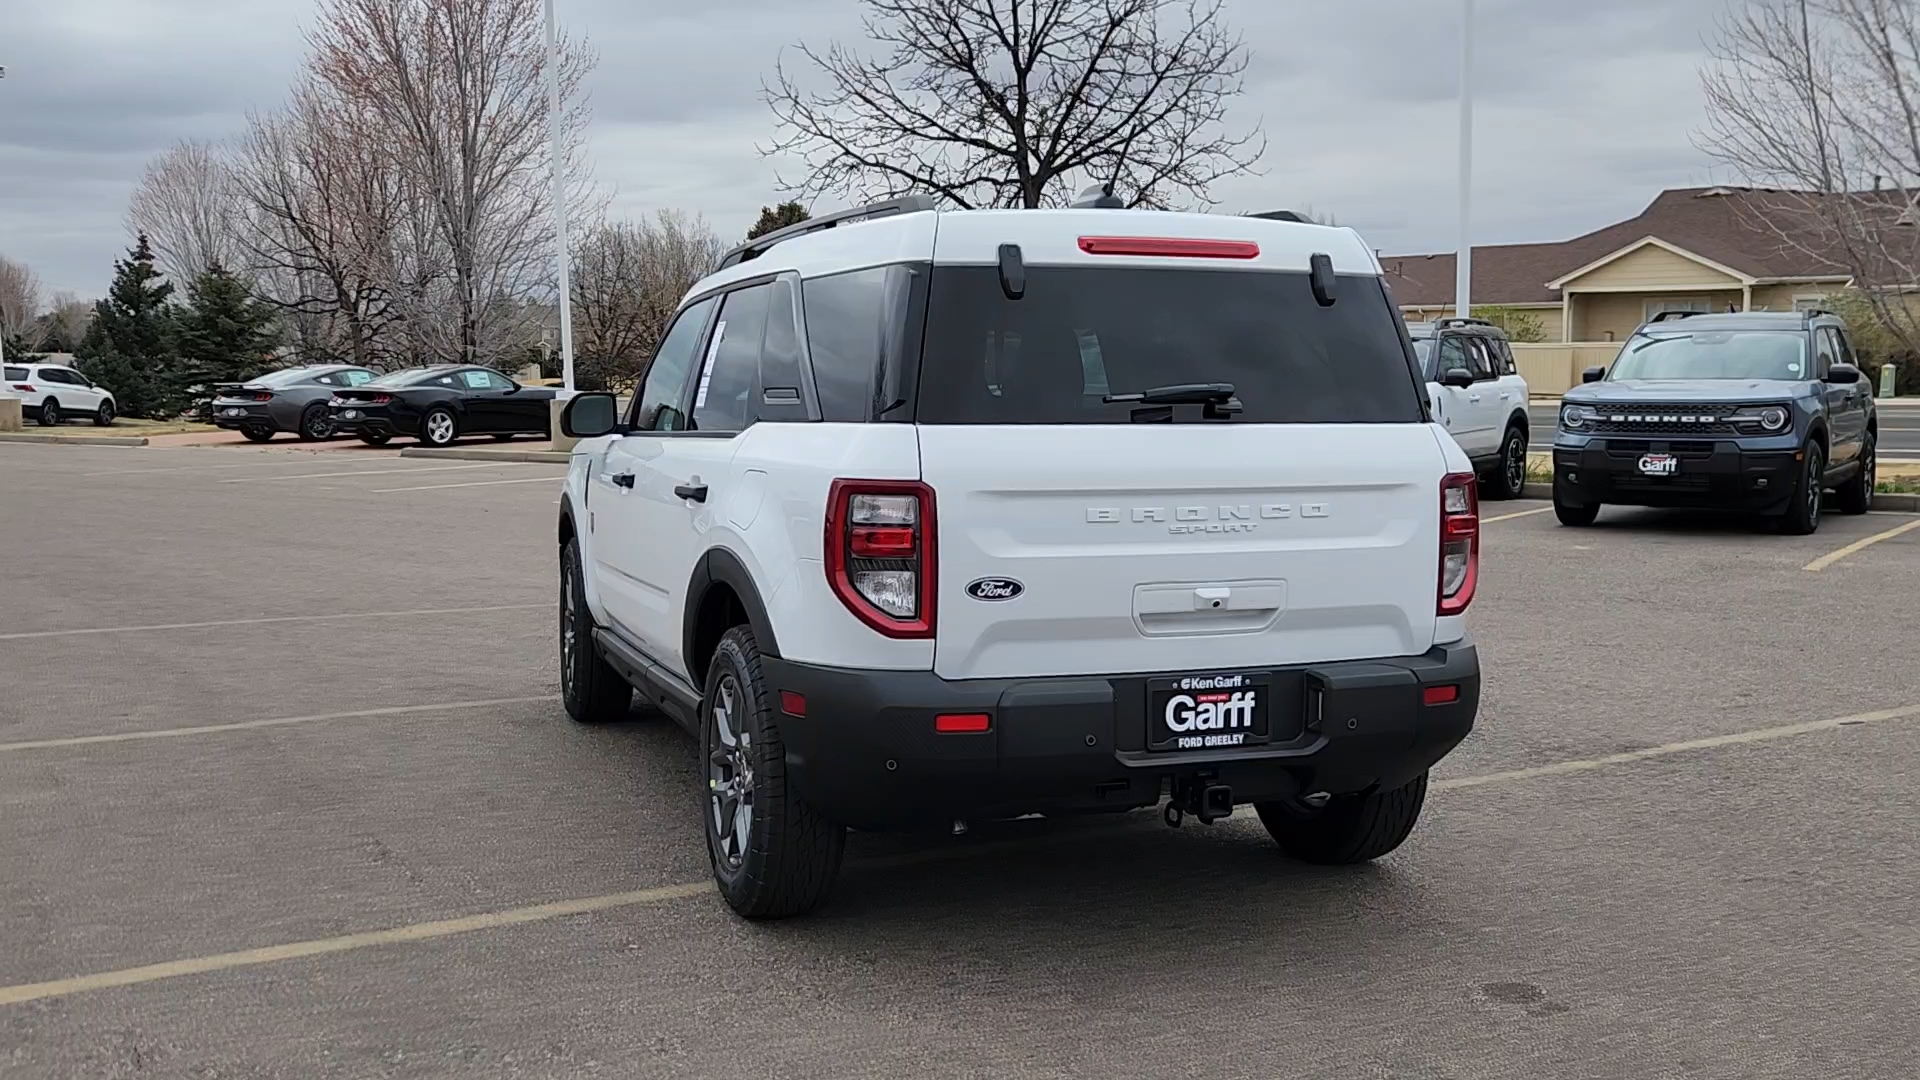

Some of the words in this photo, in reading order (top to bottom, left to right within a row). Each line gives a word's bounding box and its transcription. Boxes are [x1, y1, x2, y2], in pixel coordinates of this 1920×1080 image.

[1638, 457, 1677, 472] Garff
[1086, 503, 1330, 523] BRONCO
[1168, 523, 1259, 535] SPORT
[977, 581, 1014, 597] Ford
[1191, 677, 1214, 689] Ken
[1214, 675, 1243, 688] Garff
[1165, 691, 1256, 732] Garff
[1178, 736, 1203, 749] FORD
[1204, 734, 1244, 747] GREELEY
